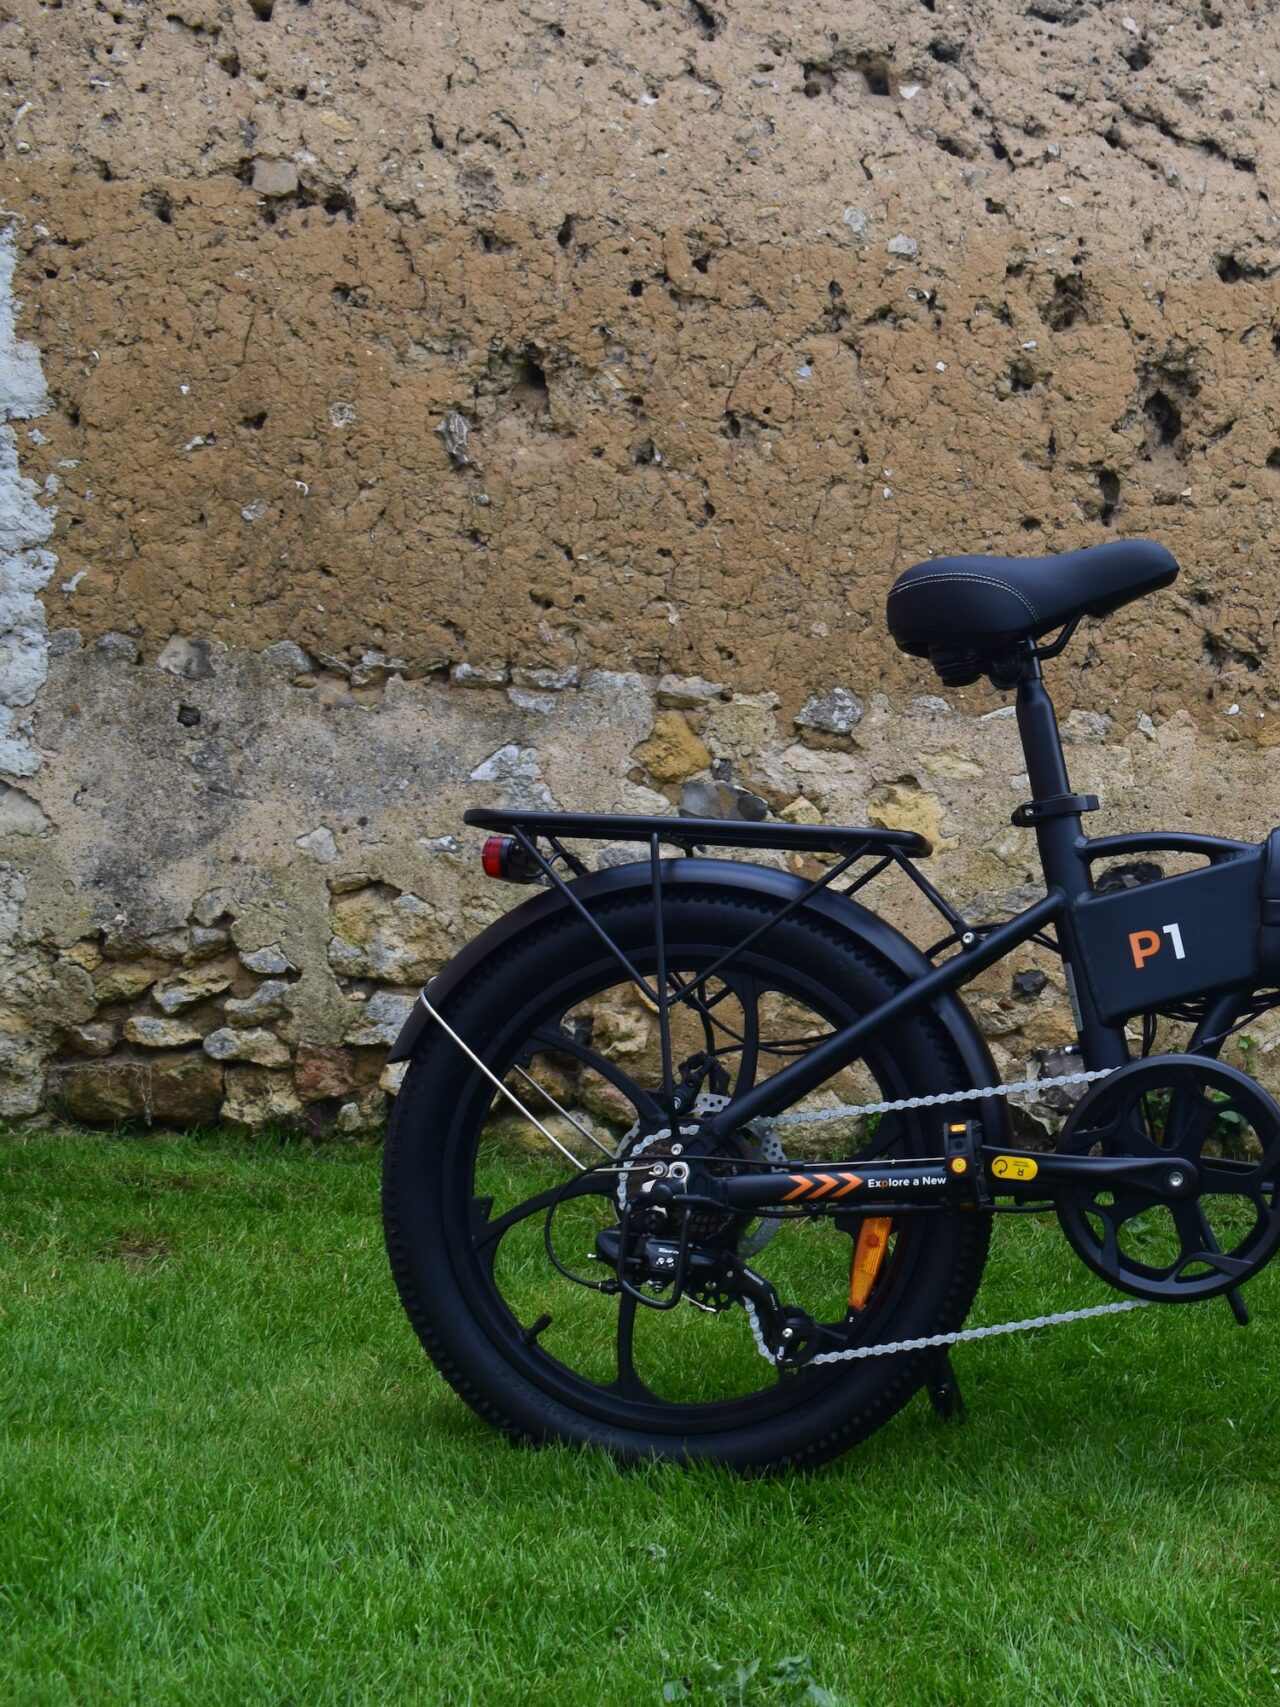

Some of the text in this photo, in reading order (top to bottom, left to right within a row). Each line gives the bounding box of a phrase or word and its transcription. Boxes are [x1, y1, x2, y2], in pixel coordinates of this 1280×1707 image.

[1128, 922, 1186, 969] P1
[1017, 1168, 1025, 1177] R
[867, 1175, 947, 1190] Explore a New
